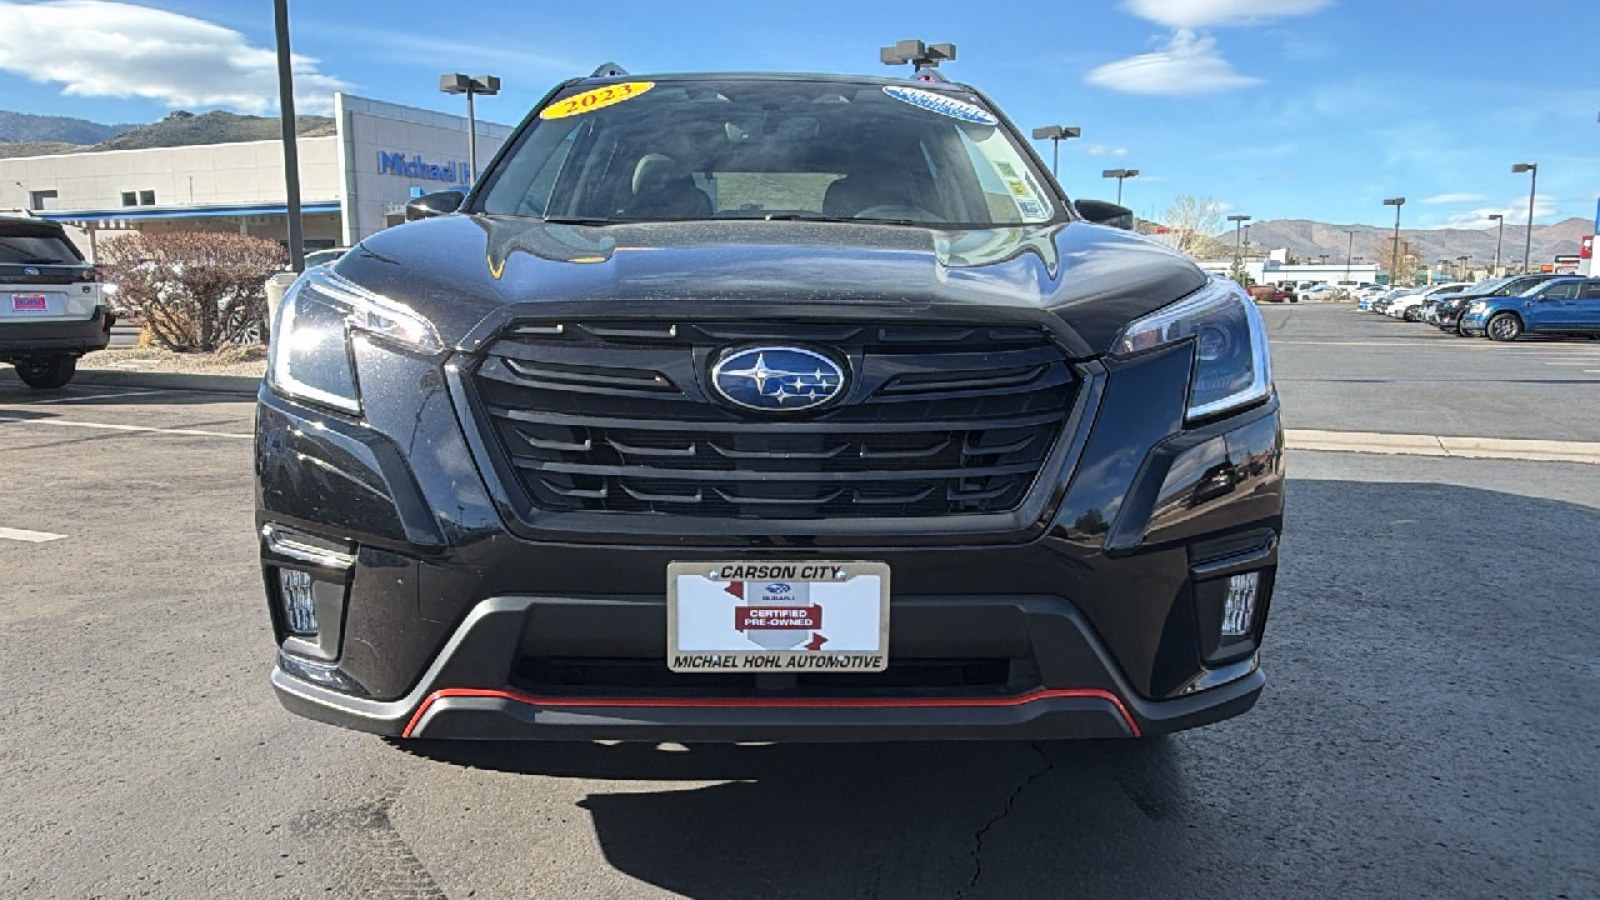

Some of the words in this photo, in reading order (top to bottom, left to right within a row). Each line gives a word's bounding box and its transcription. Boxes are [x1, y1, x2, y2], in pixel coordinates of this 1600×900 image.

[563, 84, 633, 114] 2023
[379, 149, 457, 183] Michael
[720, 565, 797, 579] CARSON
[800, 565, 842, 579] CITY
[749, 609, 808, 618] CERTIFIED
[744, 618, 814, 626] PRE-OWNED
[673, 655, 739, 668] MICHAEL
[742, 655, 782, 668] HOHL
[785, 655, 883, 668] AUTOMOTIVE
